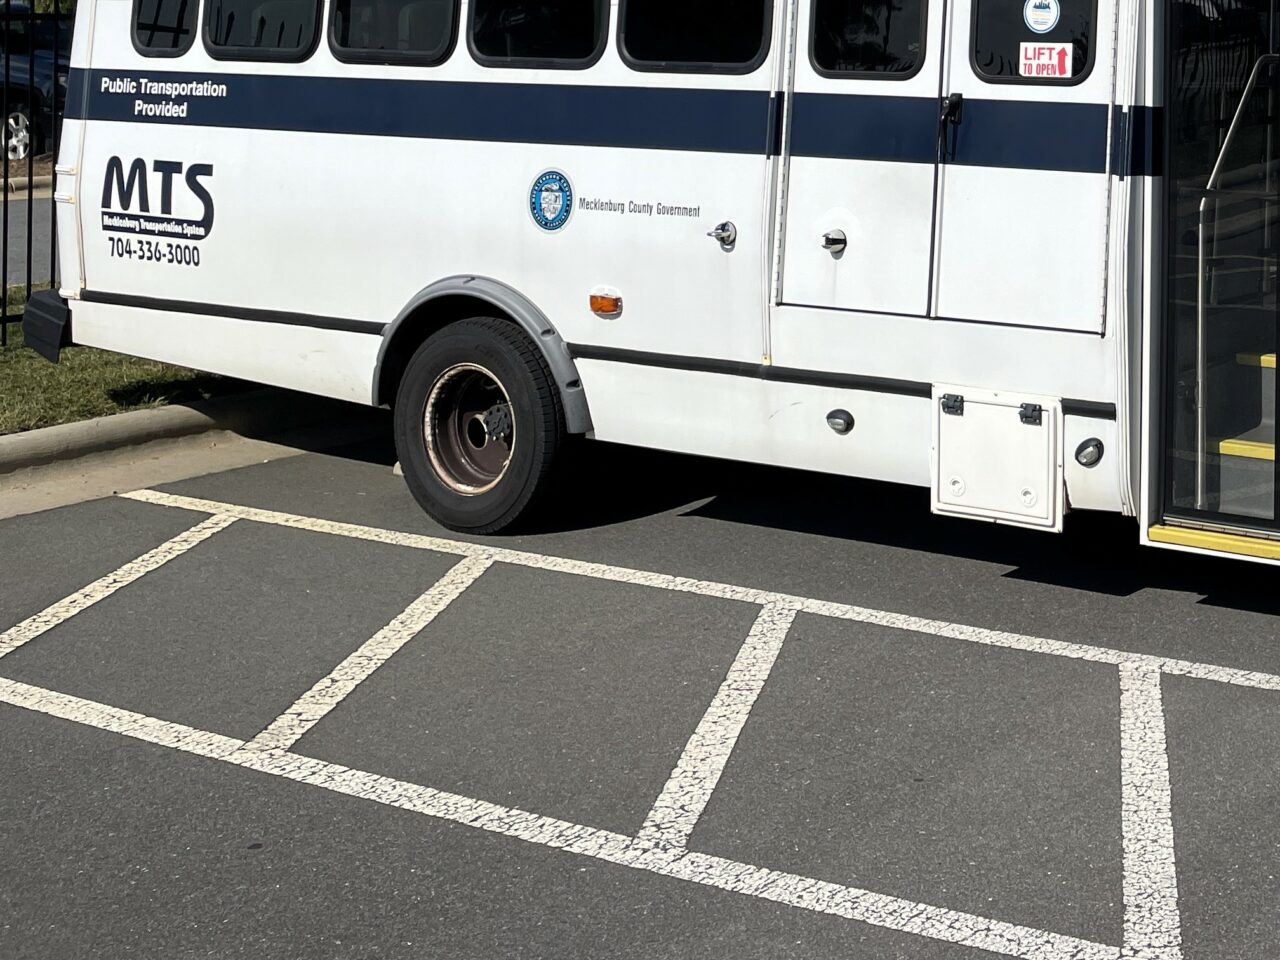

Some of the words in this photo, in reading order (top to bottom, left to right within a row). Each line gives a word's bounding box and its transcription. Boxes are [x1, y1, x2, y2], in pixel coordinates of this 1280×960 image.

[1024, 46, 1056, 61] LIFT
[1023, 62, 1033, 75] TO
[1036, 63, 1057, 76] OPEN
[101, 77, 137, 94] Public
[139, 78, 227, 99] Transportation
[134, 99, 187, 118] Provided
[100, 155, 215, 222] MTS
[578, 197, 625, 214] Mecklenburg
[628, 200, 654, 217] County
[656, 202, 701, 218] Government
[102, 214, 140, 232] Mecklenburg
[140, 218, 183, 234] Transportation
[182, 222, 206, 237] System
[108, 236, 201, 267] 704-336-3000
